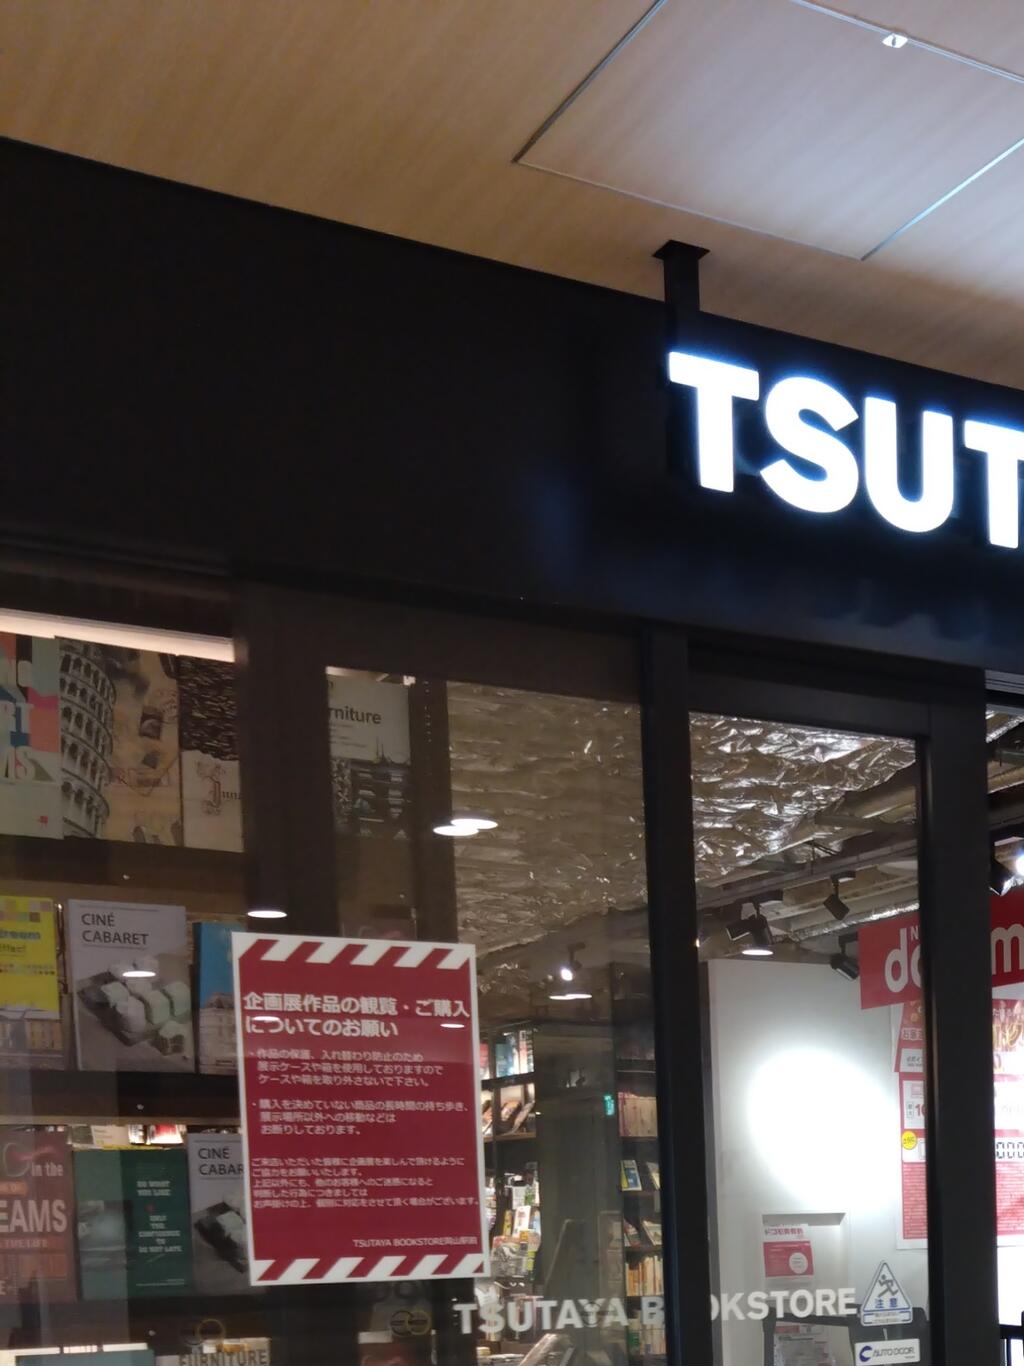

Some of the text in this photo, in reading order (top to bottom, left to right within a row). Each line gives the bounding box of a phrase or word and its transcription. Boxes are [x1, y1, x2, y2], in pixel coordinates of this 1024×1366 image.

[329, 706, 382, 724] rniture
[81, 912, 115, 927] CINÉ
[82, 930, 149, 945] CABARET
[244, 992, 470, 1018] 企画展作品の観覧・ご購入
[246, 1017, 399, 1037] についてのお願い
[199, 1164, 244, 1175] CABAR
[353, 1239, 392, 1248] TSUTAYA
[454, 1288, 858, 1335] TSUTAYA BKSTORE
